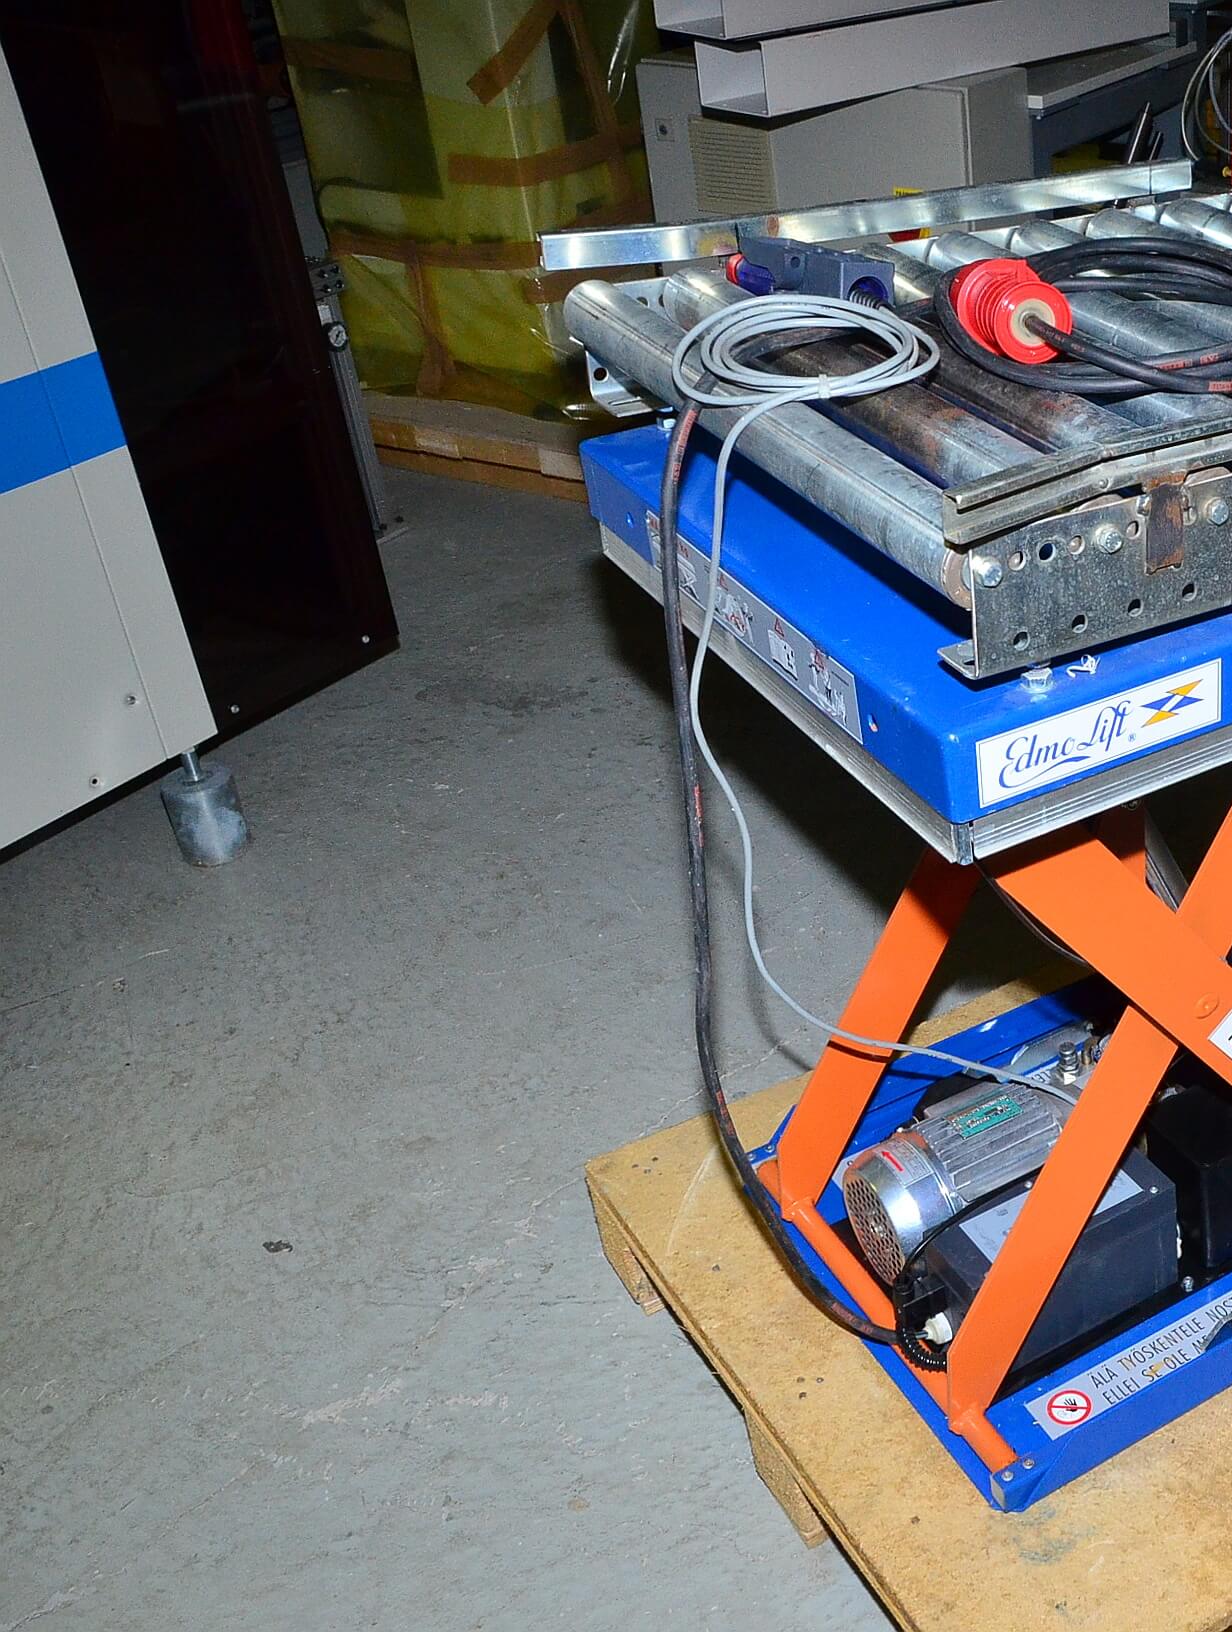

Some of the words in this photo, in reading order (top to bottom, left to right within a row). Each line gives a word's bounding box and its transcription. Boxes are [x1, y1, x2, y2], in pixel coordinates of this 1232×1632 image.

[999, 734, 1078, 788] Edmo
[1077, 700, 1131, 752] Lift
[1087, 1363, 1118, 1389] ÄLÄ
[1117, 1317, 1205, 1372] TYÖSKENTELE
[1102, 1378, 1140, 1405] ELLEI
[1141, 1364, 1163, 1382] SE
[1164, 1349, 1192, 1369] OLE
